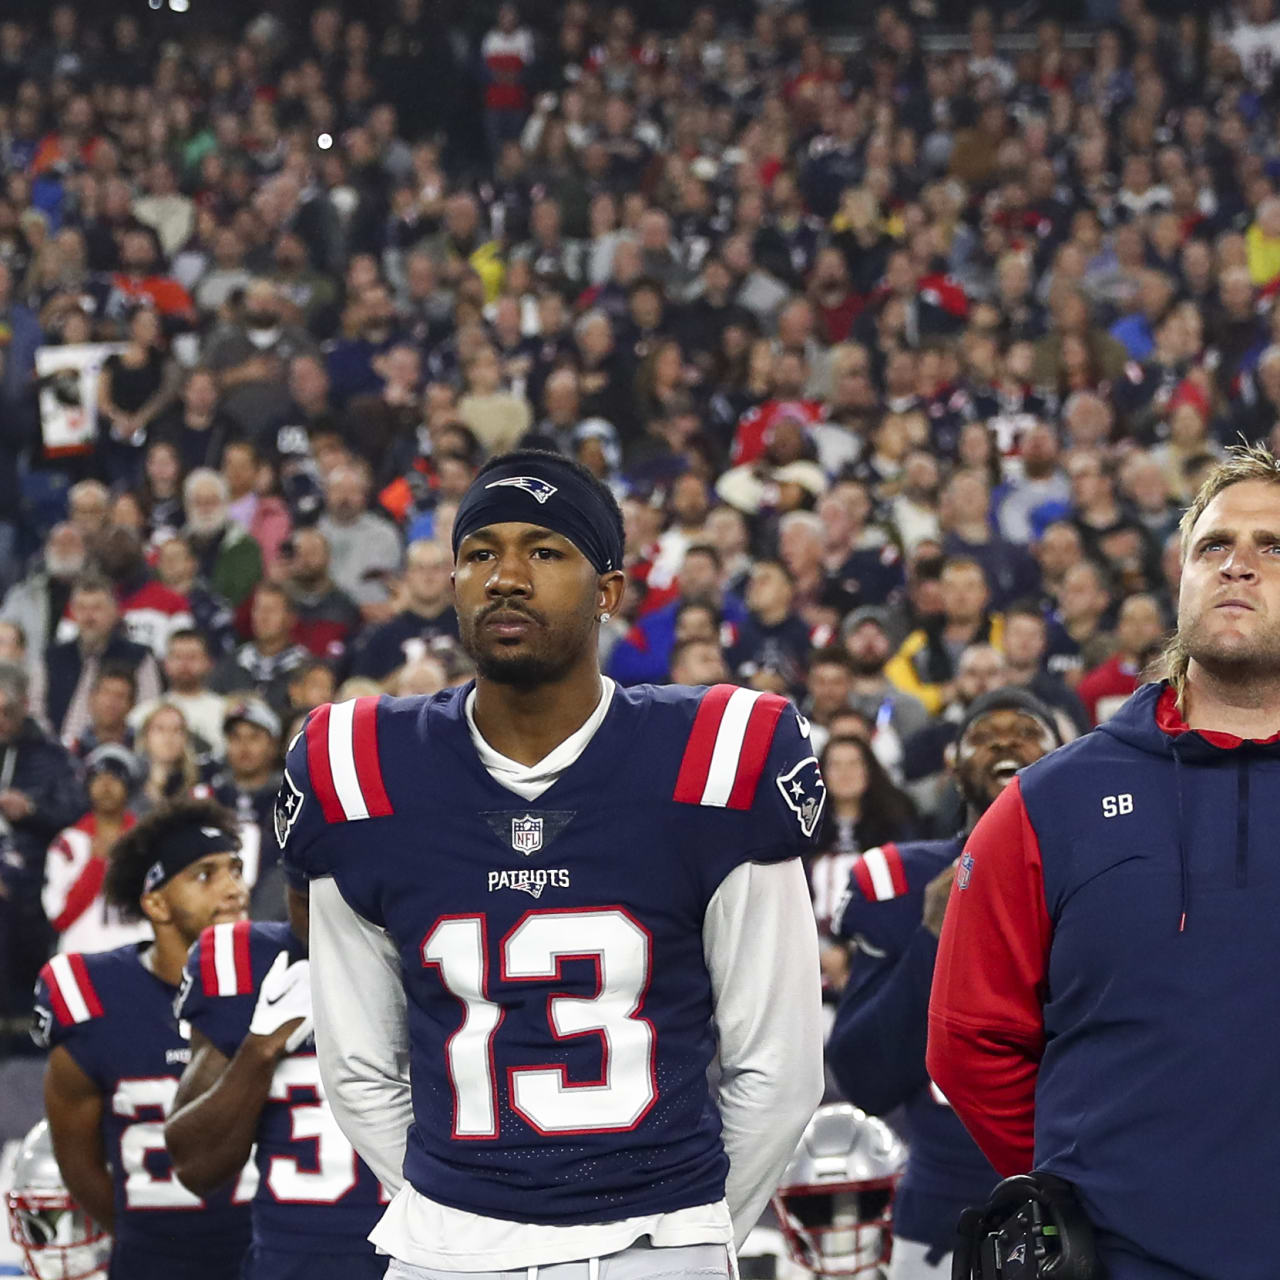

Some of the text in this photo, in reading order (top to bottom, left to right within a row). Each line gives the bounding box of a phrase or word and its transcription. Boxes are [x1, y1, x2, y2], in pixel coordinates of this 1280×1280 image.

[1102, 793, 1134, 818] SB
[488, 869, 570, 892] PATRIOTS
[420, 904, 660, 1140] 13
[267, 1052, 392, 1207] 3
